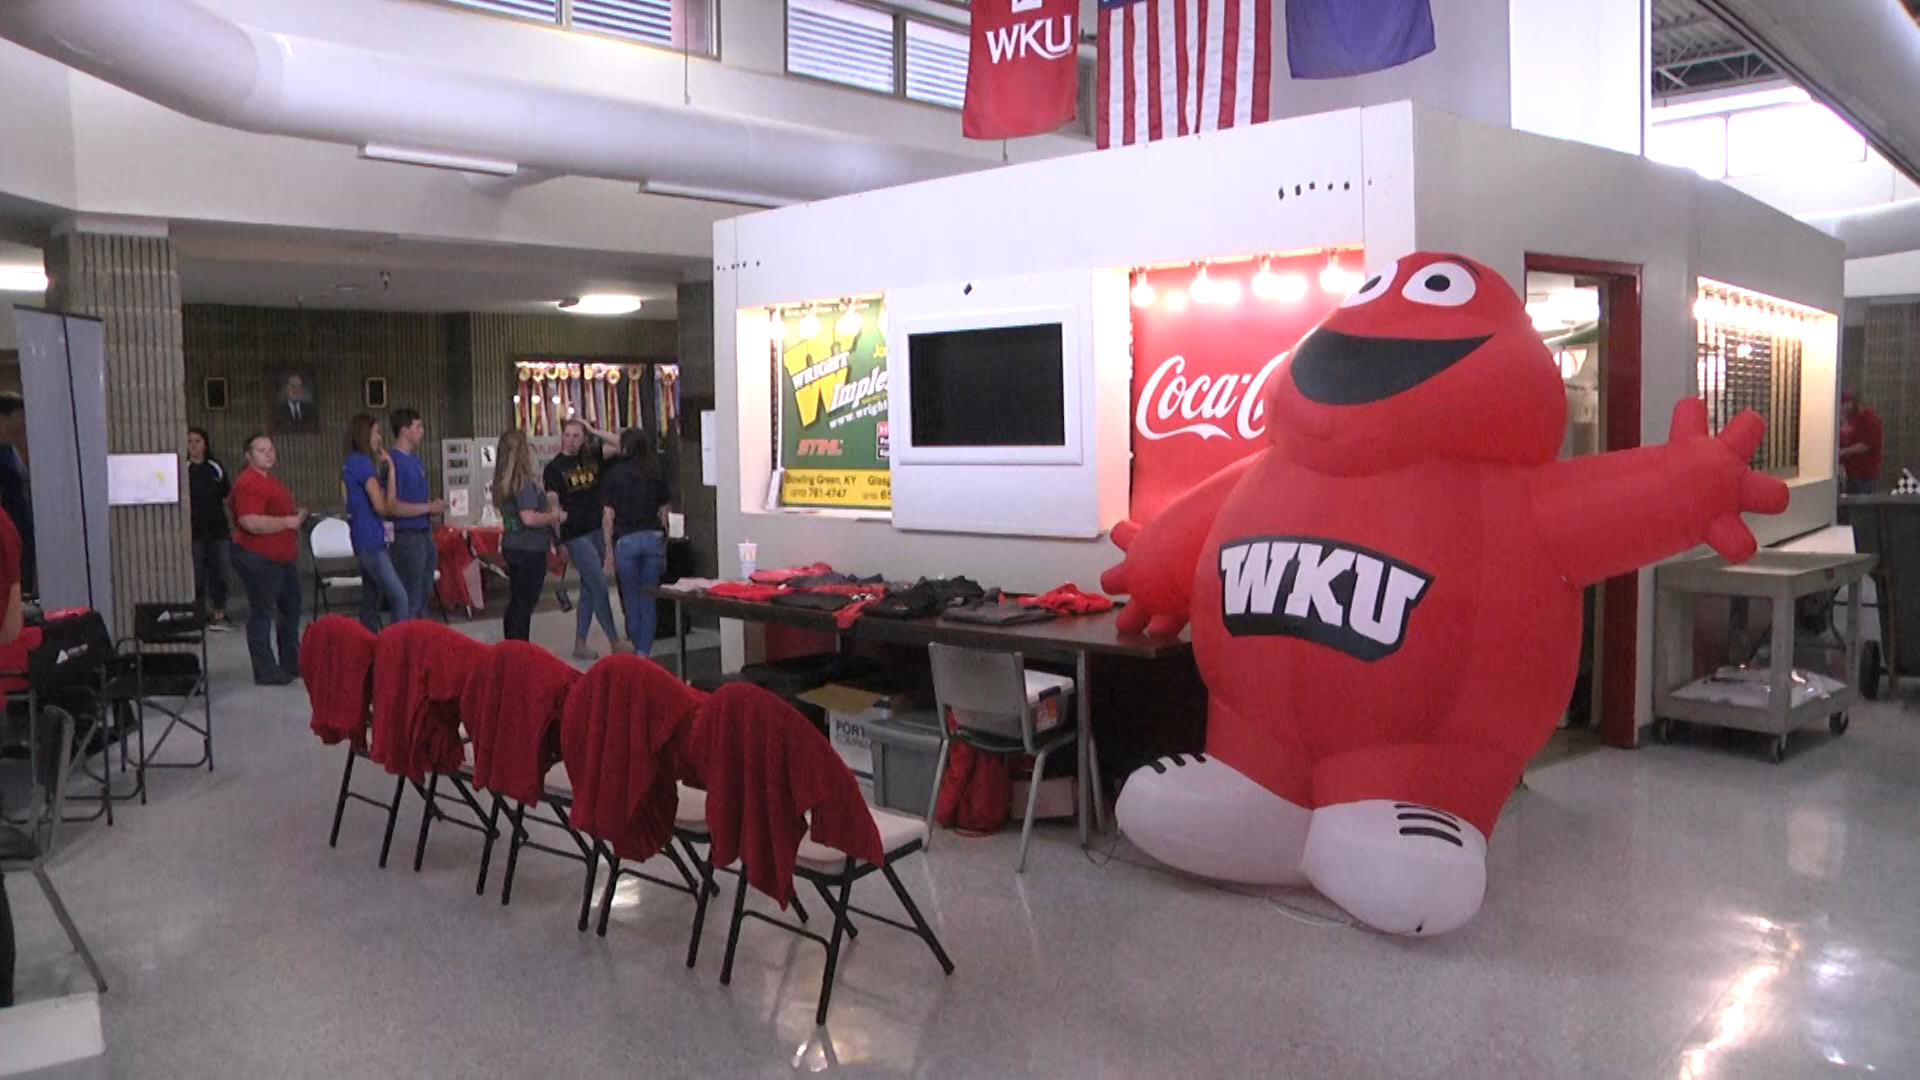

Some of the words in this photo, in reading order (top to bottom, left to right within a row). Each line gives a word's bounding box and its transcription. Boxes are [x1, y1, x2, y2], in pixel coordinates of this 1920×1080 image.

[985, 14, 1073, 64] WKU
[792, 351, 850, 390] WRIGHT
[829, 366, 888, 411] Imple
[1136, 352, 1289, 440] Coca-C
[844, 475, 857, 485] KY
[1221, 541, 1426, 645] WKU
